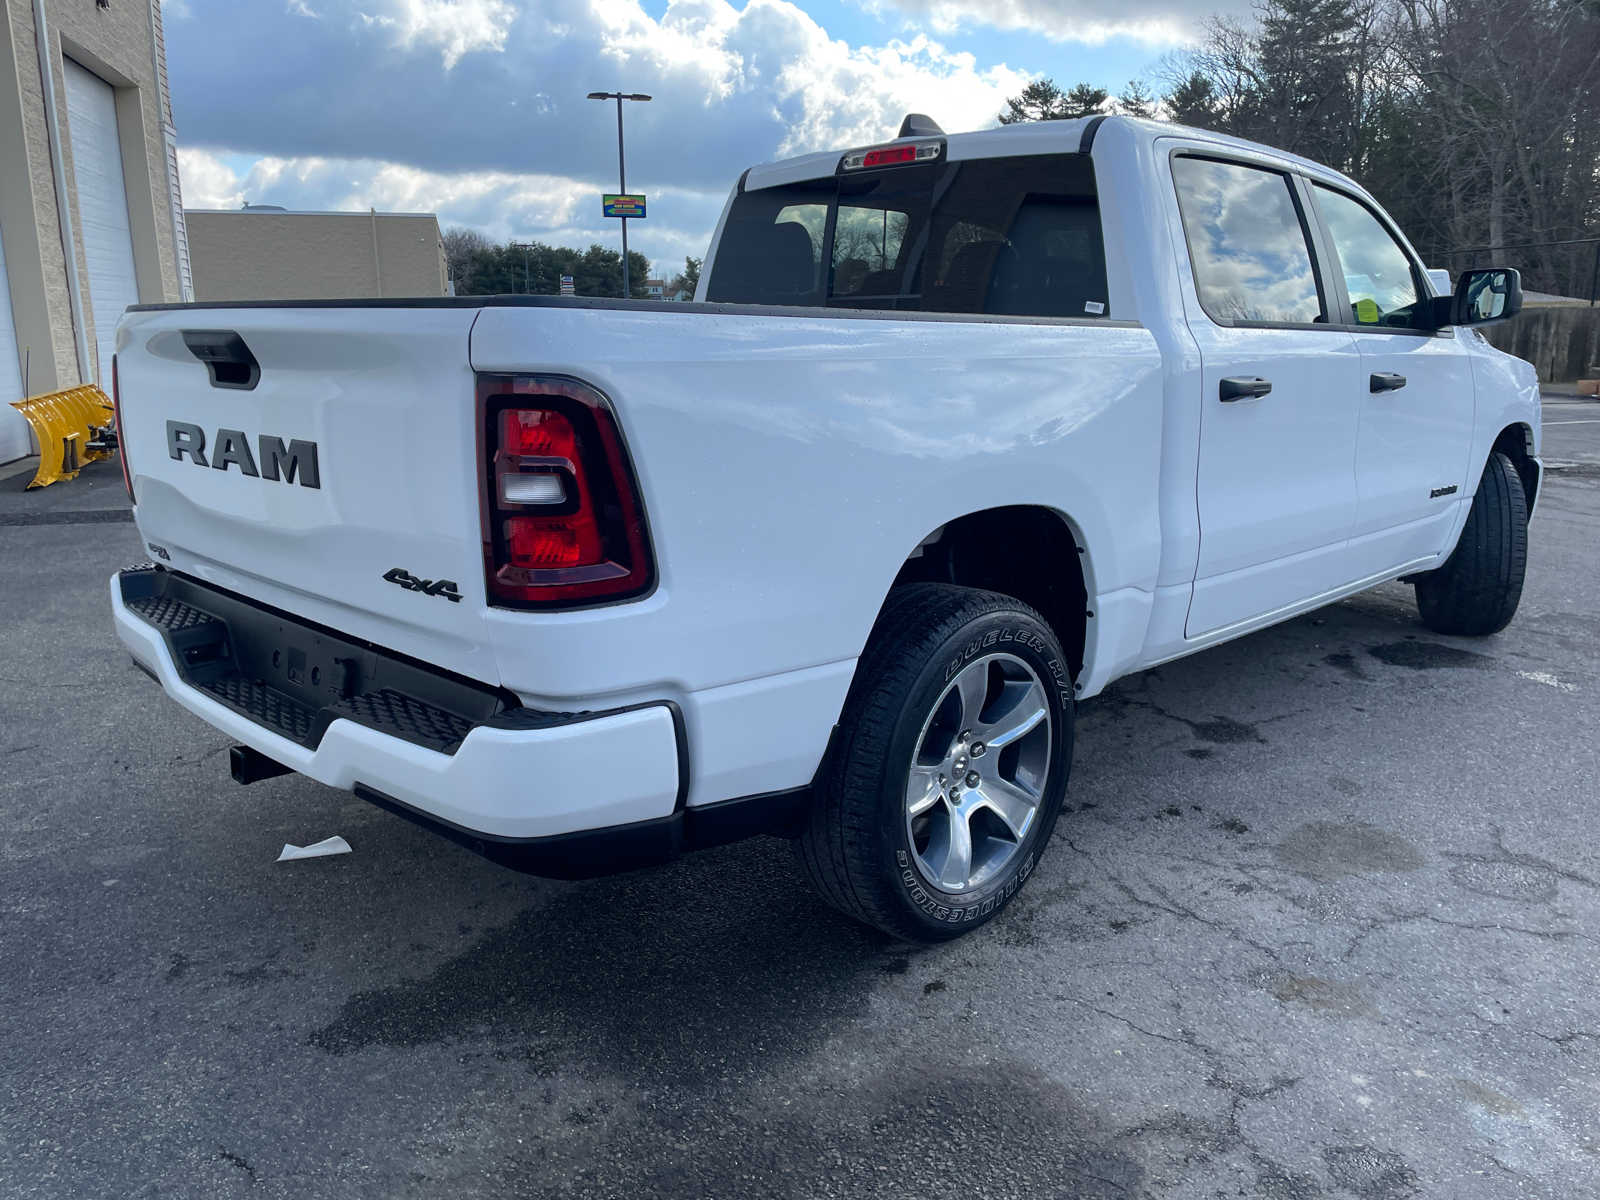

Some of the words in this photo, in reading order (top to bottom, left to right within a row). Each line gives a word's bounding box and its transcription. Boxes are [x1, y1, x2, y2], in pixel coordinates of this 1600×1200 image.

[166, 419, 321, 490] RAM
[945, 628, 1045, 681] DUELER
[896, 850, 1034, 923] BRIDGESTONE
